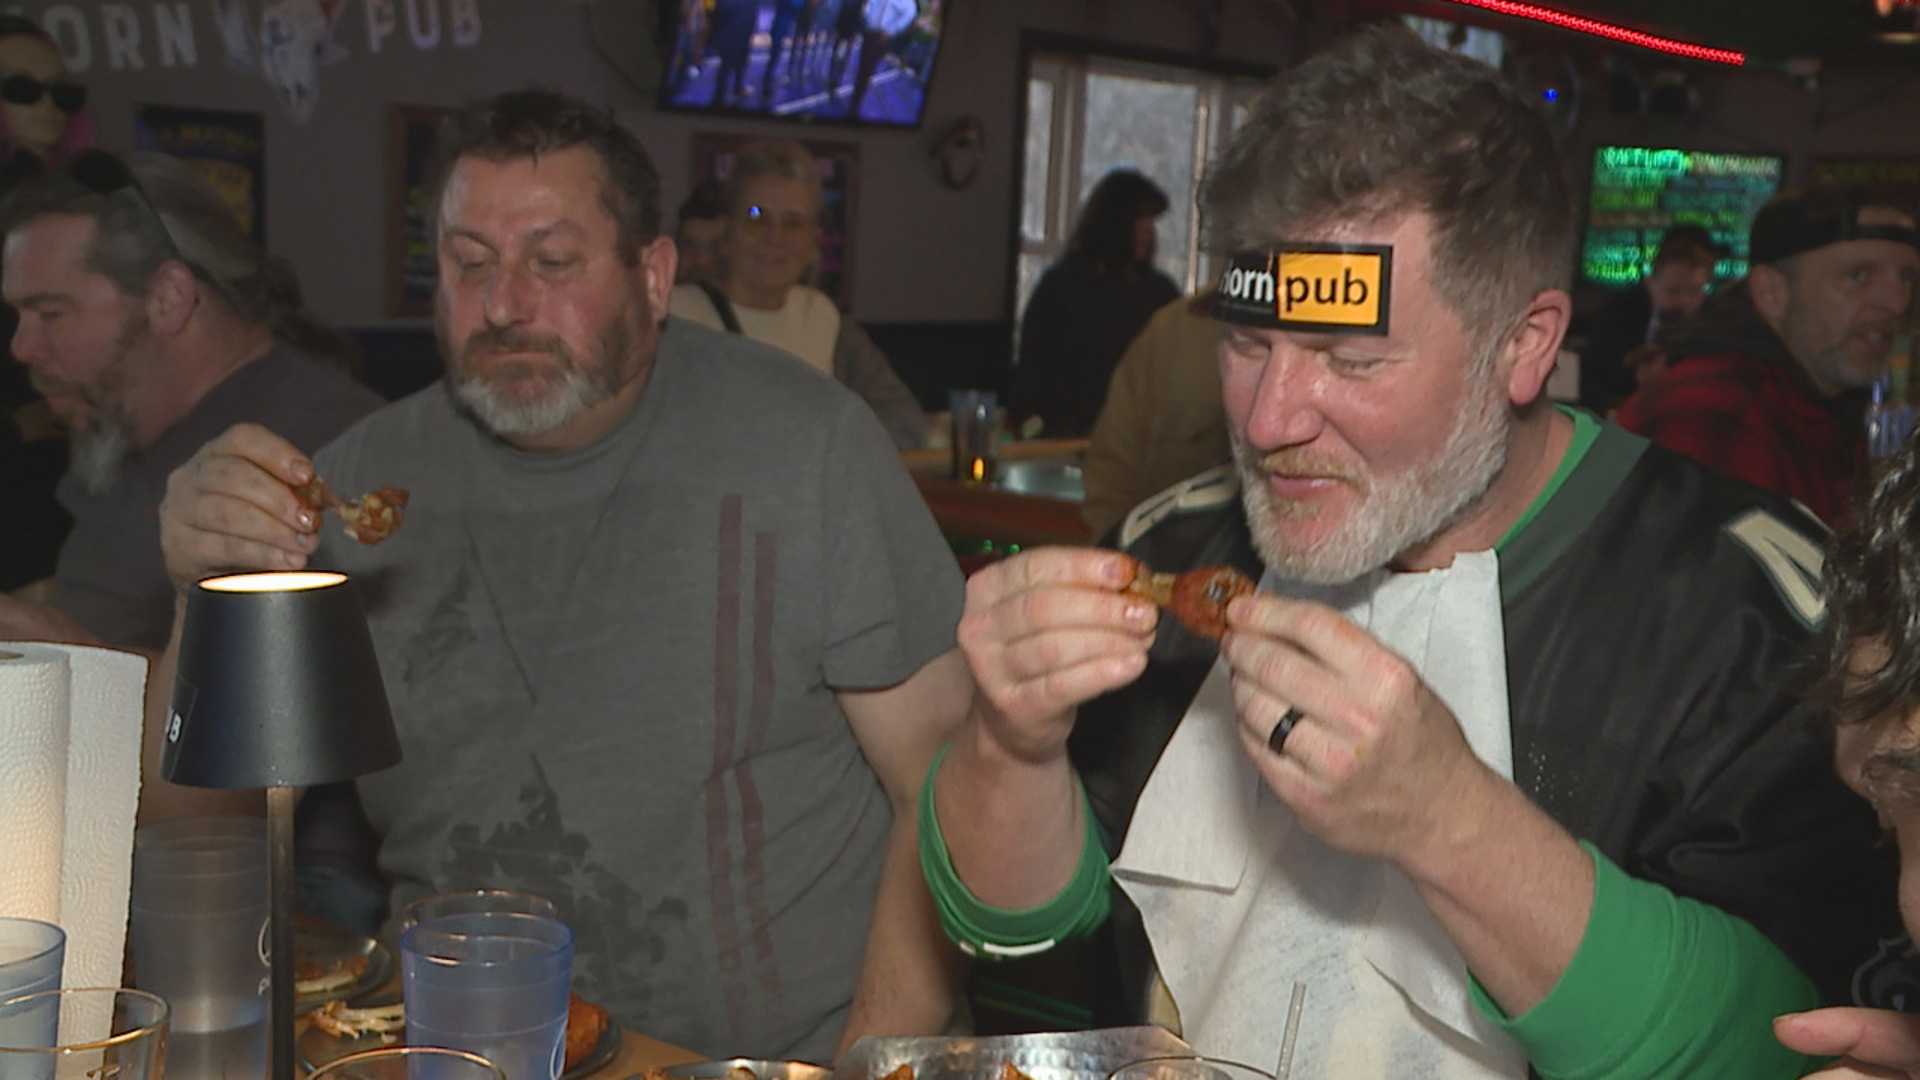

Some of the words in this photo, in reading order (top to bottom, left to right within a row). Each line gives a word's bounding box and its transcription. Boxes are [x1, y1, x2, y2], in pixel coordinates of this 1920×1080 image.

[5, 3, 199, 74] ORN
[365, 0, 483, 53] PUB
[1286, 268, 1367, 312] pub
